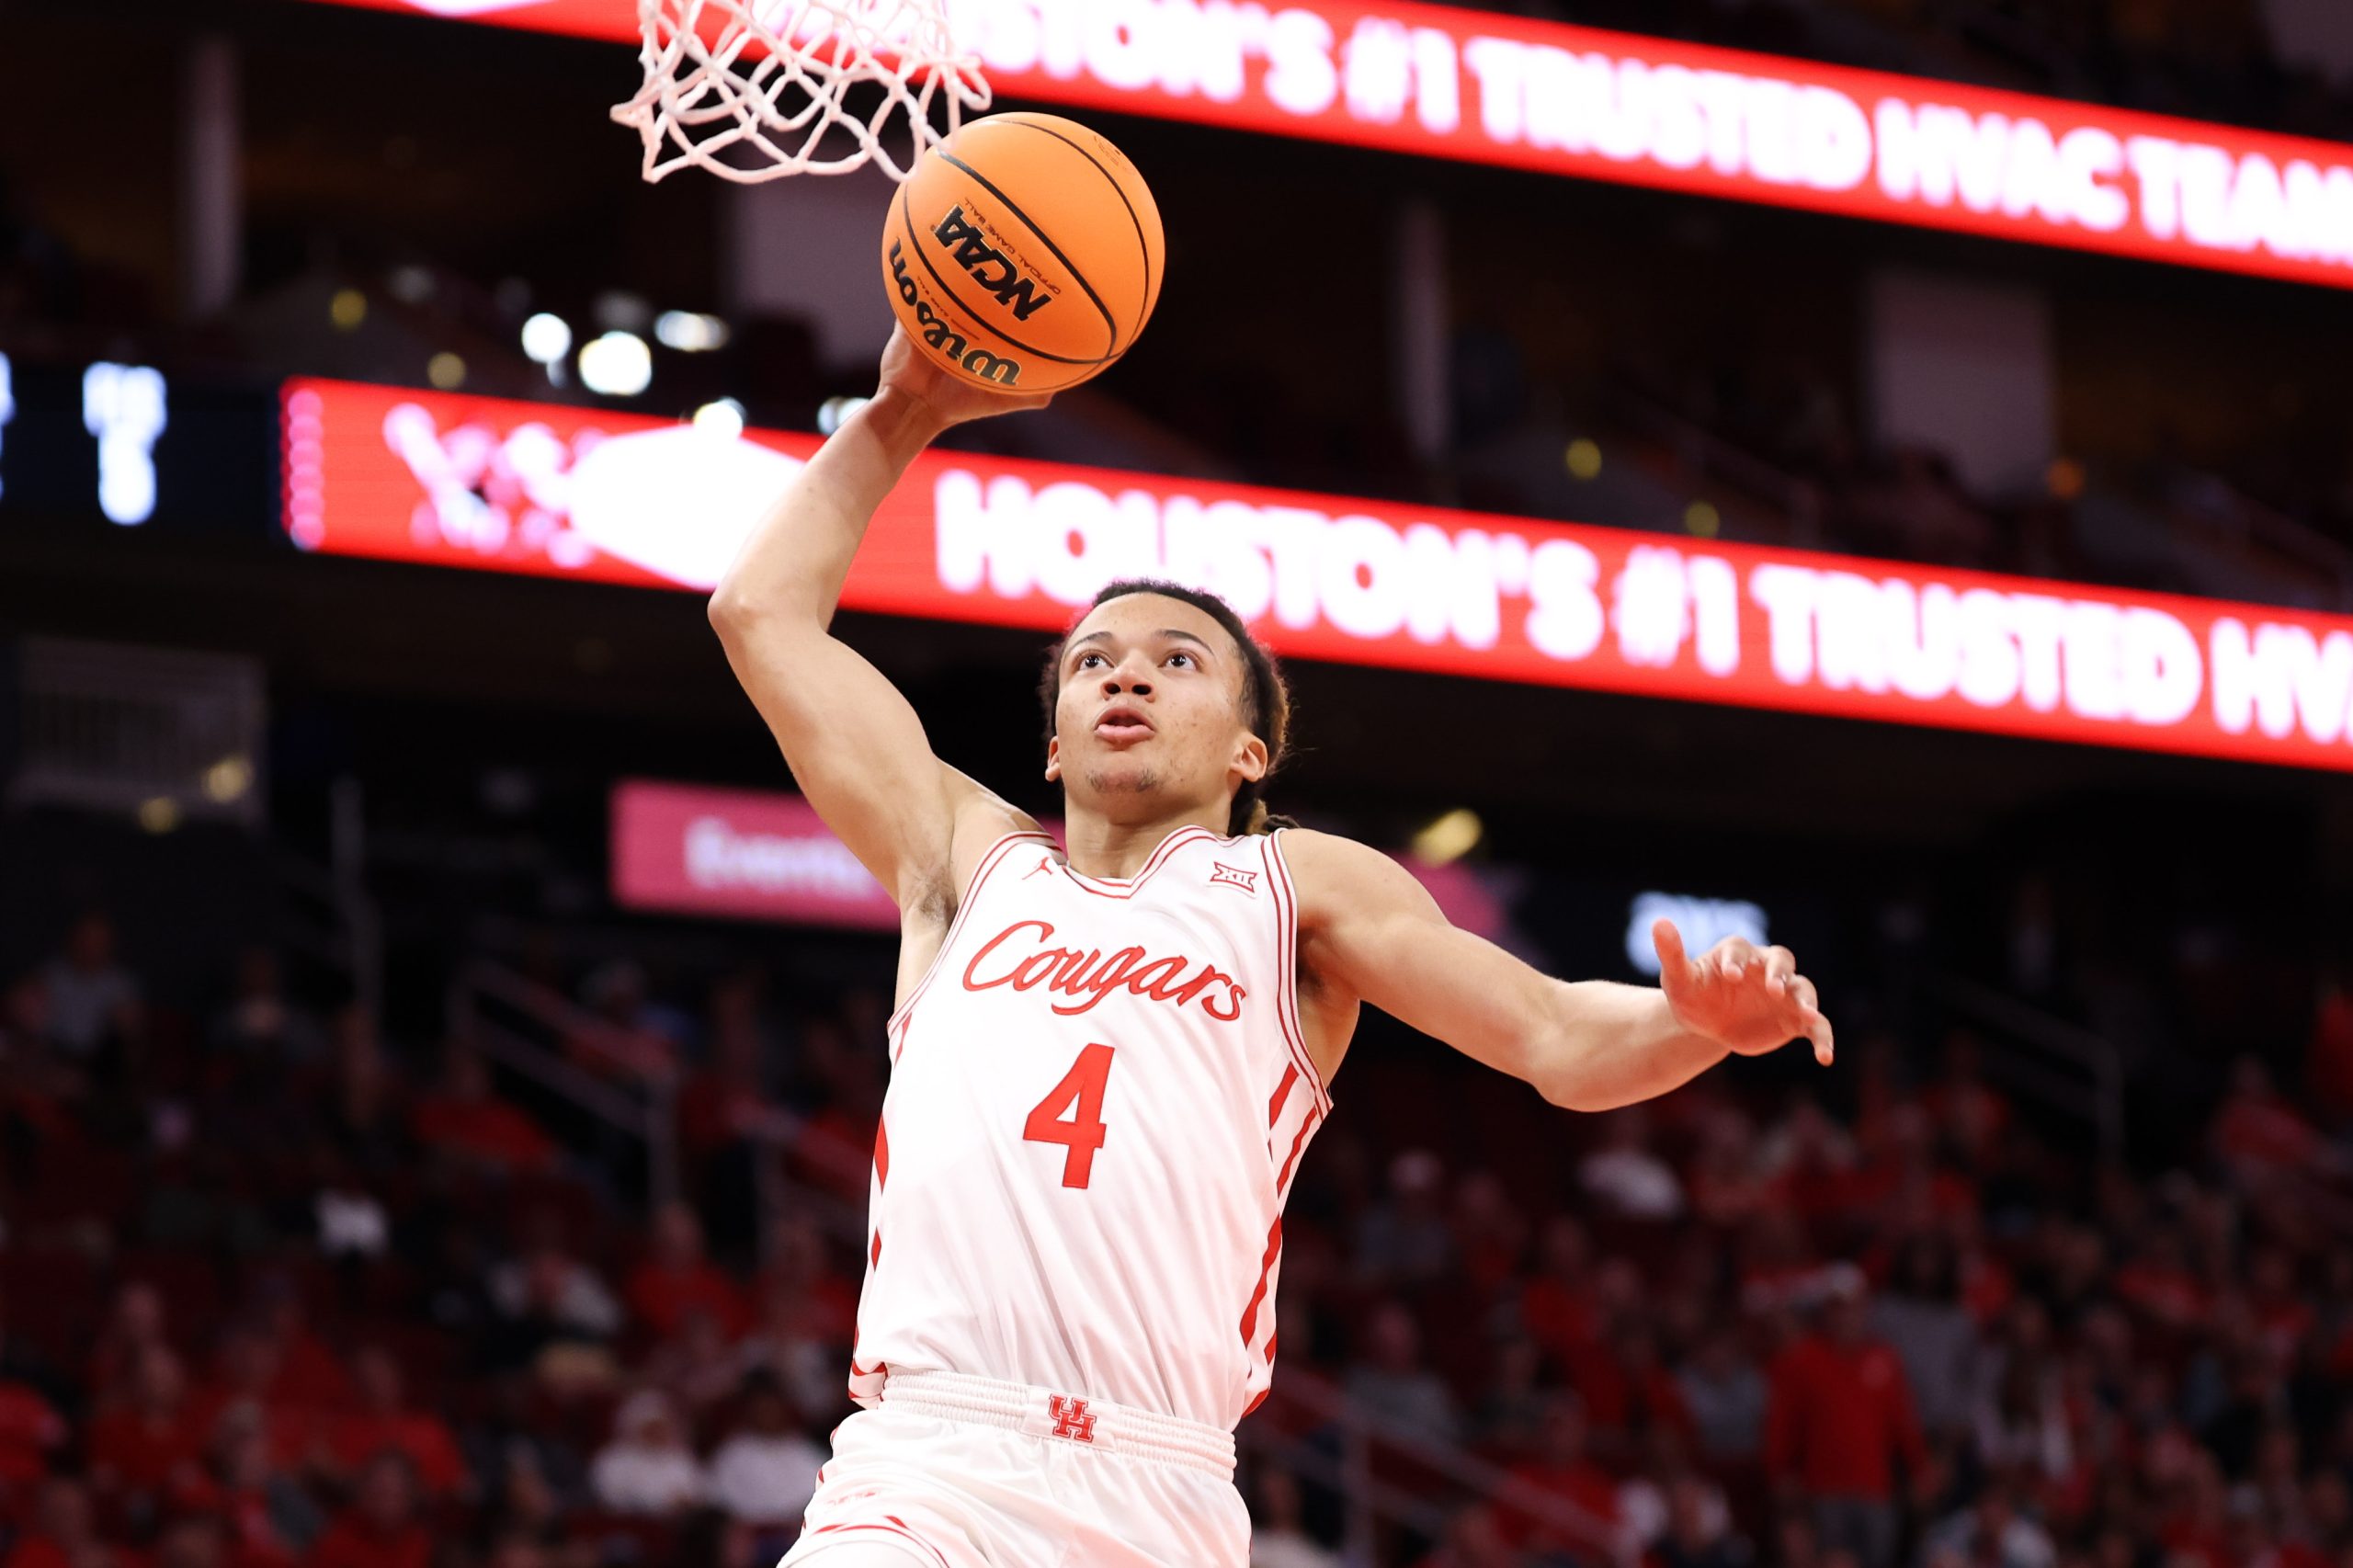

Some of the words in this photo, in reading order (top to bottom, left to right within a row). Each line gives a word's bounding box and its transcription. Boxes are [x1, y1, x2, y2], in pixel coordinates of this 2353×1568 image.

[1343, 17, 1461, 132] #1
[1464, 37, 1872, 190] TRUSTED
[1874, 98, 2130, 231] HVAC
[933, 203, 1053, 322] NCAA
[964, 197, 986, 224] BALL
[986, 224, 1016, 255] GAME
[890, 236, 1021, 386] Wilson
[1017, 253, 1062, 295] OFFICIAL
[935, 470, 1605, 660] HOUSTON'S
[1610, 547, 1741, 676] #1
[1748, 563, 2203, 725] TRUSTED
[2209, 619, 2353, 743] HV
[962, 920, 1246, 1021] Cougars
[1023, 1043, 1115, 1189] 4
[1049, 1393, 1097, 1443] UH
